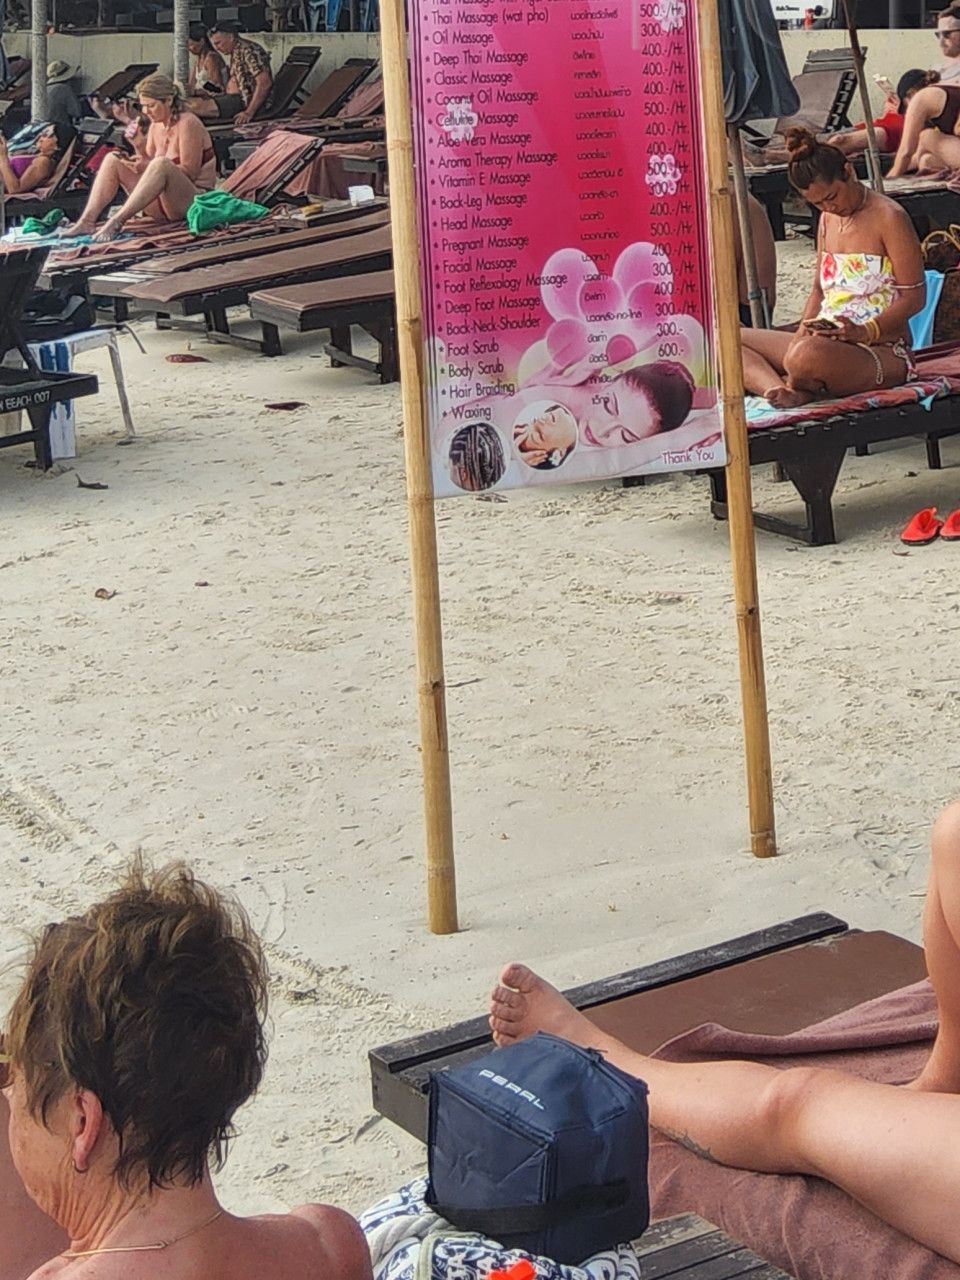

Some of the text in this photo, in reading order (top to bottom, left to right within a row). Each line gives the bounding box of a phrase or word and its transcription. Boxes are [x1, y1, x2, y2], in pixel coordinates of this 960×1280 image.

[432, 10, 452, 24] Thai
[458, 11, 498, 26] Massage
[433, 29, 494, 47] Oil Massage
[434, 50, 528, 68] Deep Thai Massage
[435, 70, 513, 86] Classic Massage
[435, 89, 539, 105] Coconut Oil Massage
[478, 112, 519, 127] Massage
[464, 133, 486, 146] Vera
[490, 133, 532, 147] Massage
[438, 151, 558, 168] Aroma Therapy Massage
[439, 172, 531, 188] Vitamin E Massage
[440, 193, 527, 211] Back-Leg Massage
[441, 214, 512, 230] Head Massage
[442, 235, 529, 255] Pregnant Massage
[443, 256, 517, 274] Facial Massage
[444, 273, 568, 293] Foot Reflexology Massage
[445, 296, 540, 316] Deep Foot Massage
[447, 337, 499, 357] Foot Scrub
[449, 358, 504, 380] Body Scrub
[450, 379, 515, 399] Hair Braiding
[5, 395, 31, 409] BEACH
[34, 391, 50, 403] 007
[452, 404, 491, 419] Waxing
[662, 449, 714, 464] Thank You
